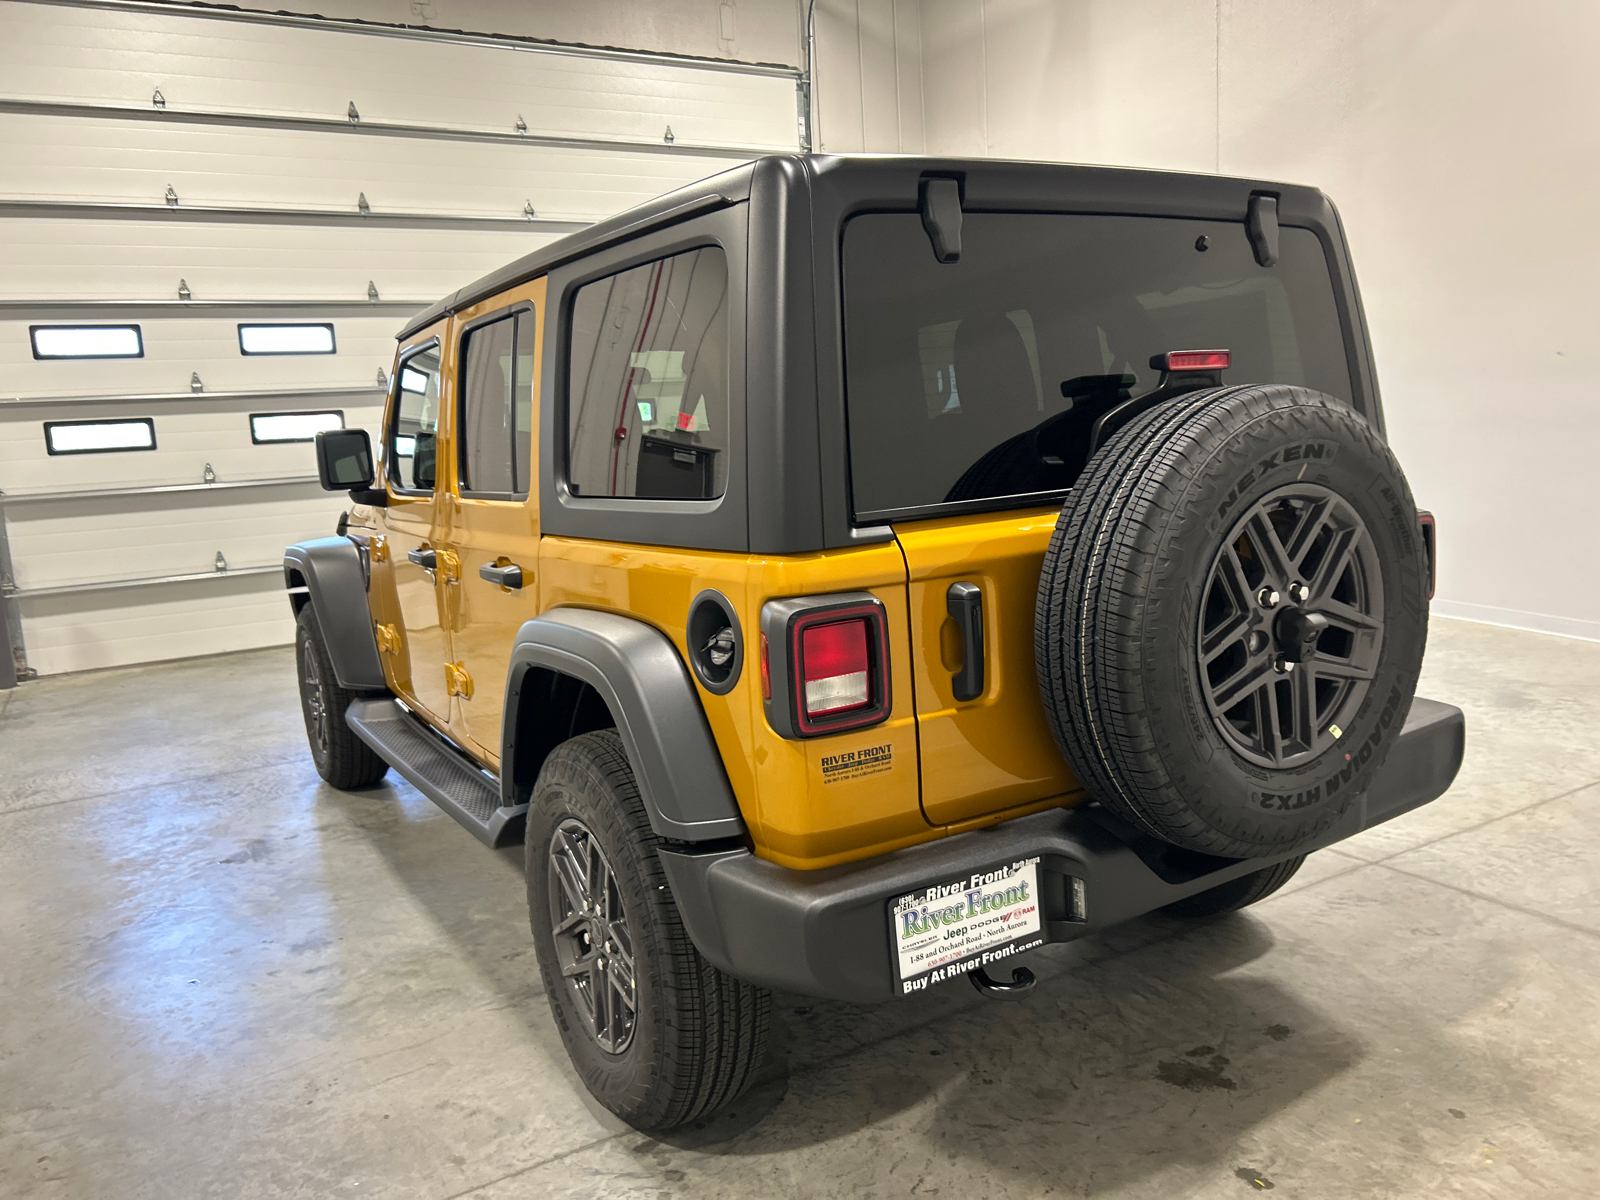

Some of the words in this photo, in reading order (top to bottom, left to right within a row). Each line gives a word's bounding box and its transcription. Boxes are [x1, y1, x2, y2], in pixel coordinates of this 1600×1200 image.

[1218, 443, 1325, 519] NEXEN
[821, 752, 855, 766] RIVER
[857, 744, 892, 759] FRONT
[1326, 684, 1402, 797] ROADIAN
[1259, 785, 1321, 811] HTX2
[926, 880, 967, 902] River
[970, 865, 1009, 888] Front
[970, 914, 1006, 930] DODGE
[1022, 905, 1035, 915] RAM
[925, 948, 938, 958] and
[938, 940, 965, 953] Orchard
[966, 933, 982, 944] Road
[986, 925, 1006, 938] North
[1006, 920, 1027, 931] Aurora
[943, 926, 968, 940] Jeep
[902, 976, 929, 994] Buy
[930, 968, 946, 983] At
[947, 957, 980, 978] River
[982, 939, 1043, 965] Front.com
